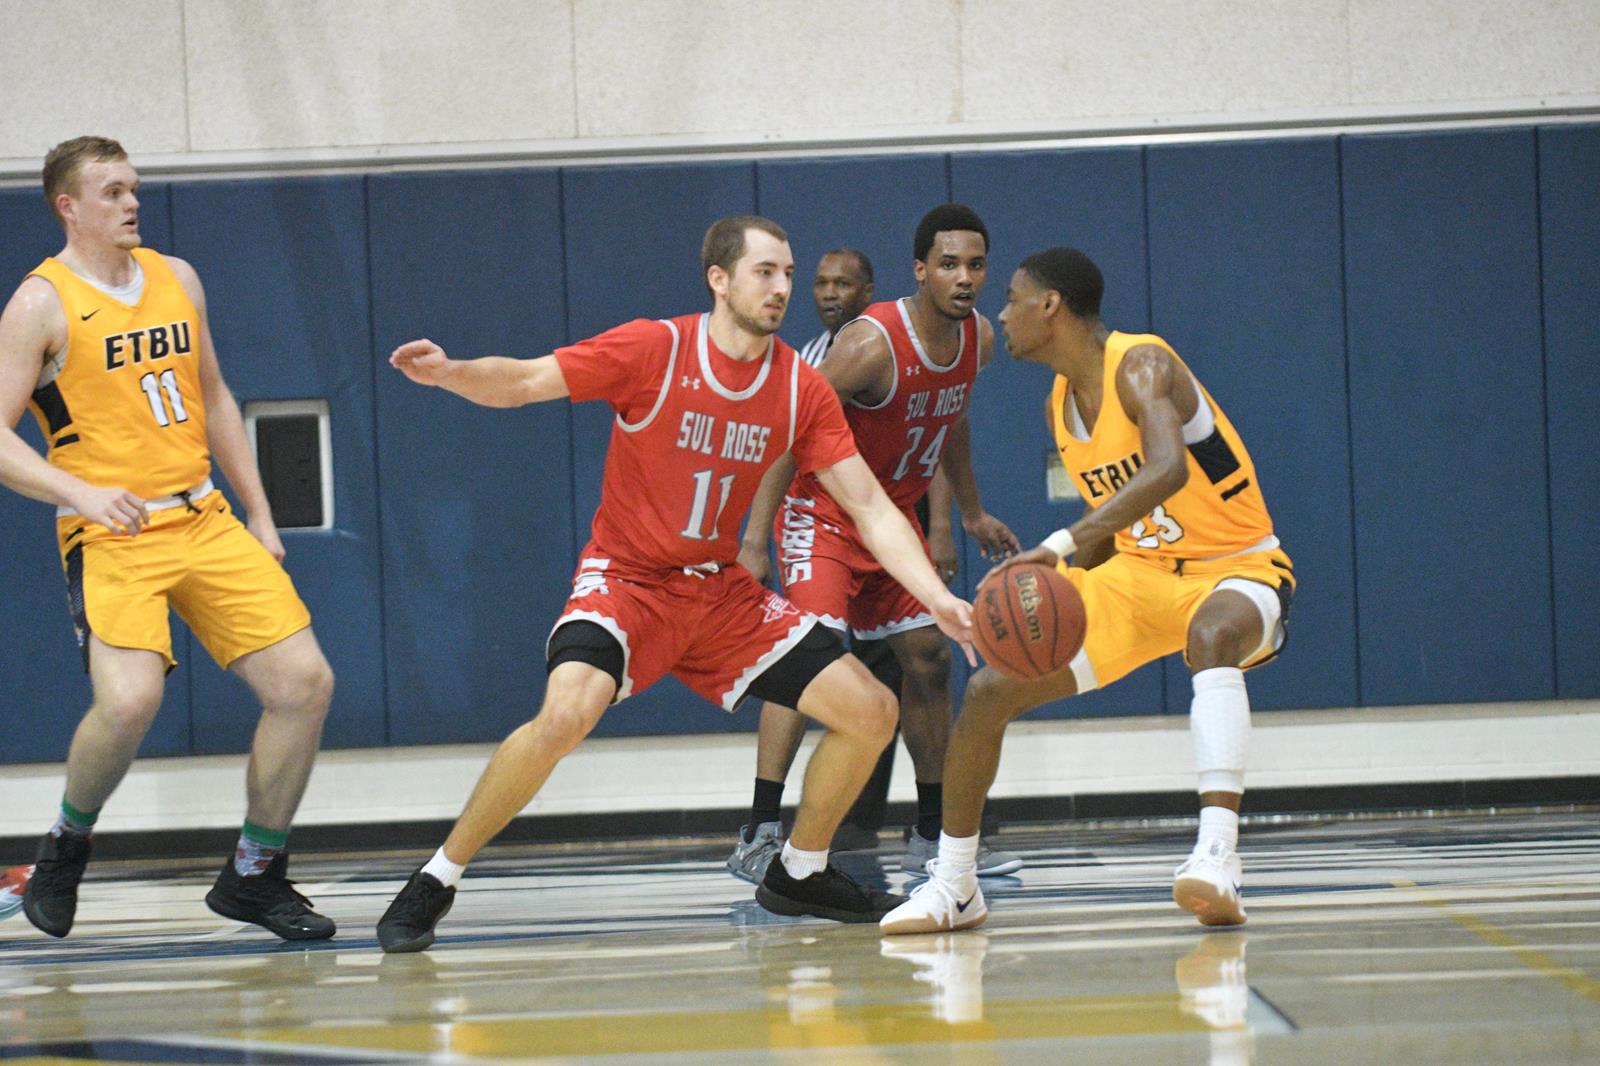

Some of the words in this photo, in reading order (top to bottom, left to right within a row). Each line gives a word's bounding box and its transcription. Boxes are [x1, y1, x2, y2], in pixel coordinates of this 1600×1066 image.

[105, 320, 192, 371] ETBU
[140, 368, 189, 428] 11
[904, 391, 928, 422] SUL
[932, 382, 967, 417] ROSS
[676, 410, 716, 455] SUL
[720, 420, 771, 464] ROSS
[892, 424, 948, 481] 24
[679, 469, 736, 541] 11
[781, 495, 816, 587] LOBOS
[1015, 572, 1042, 643] Wilson
